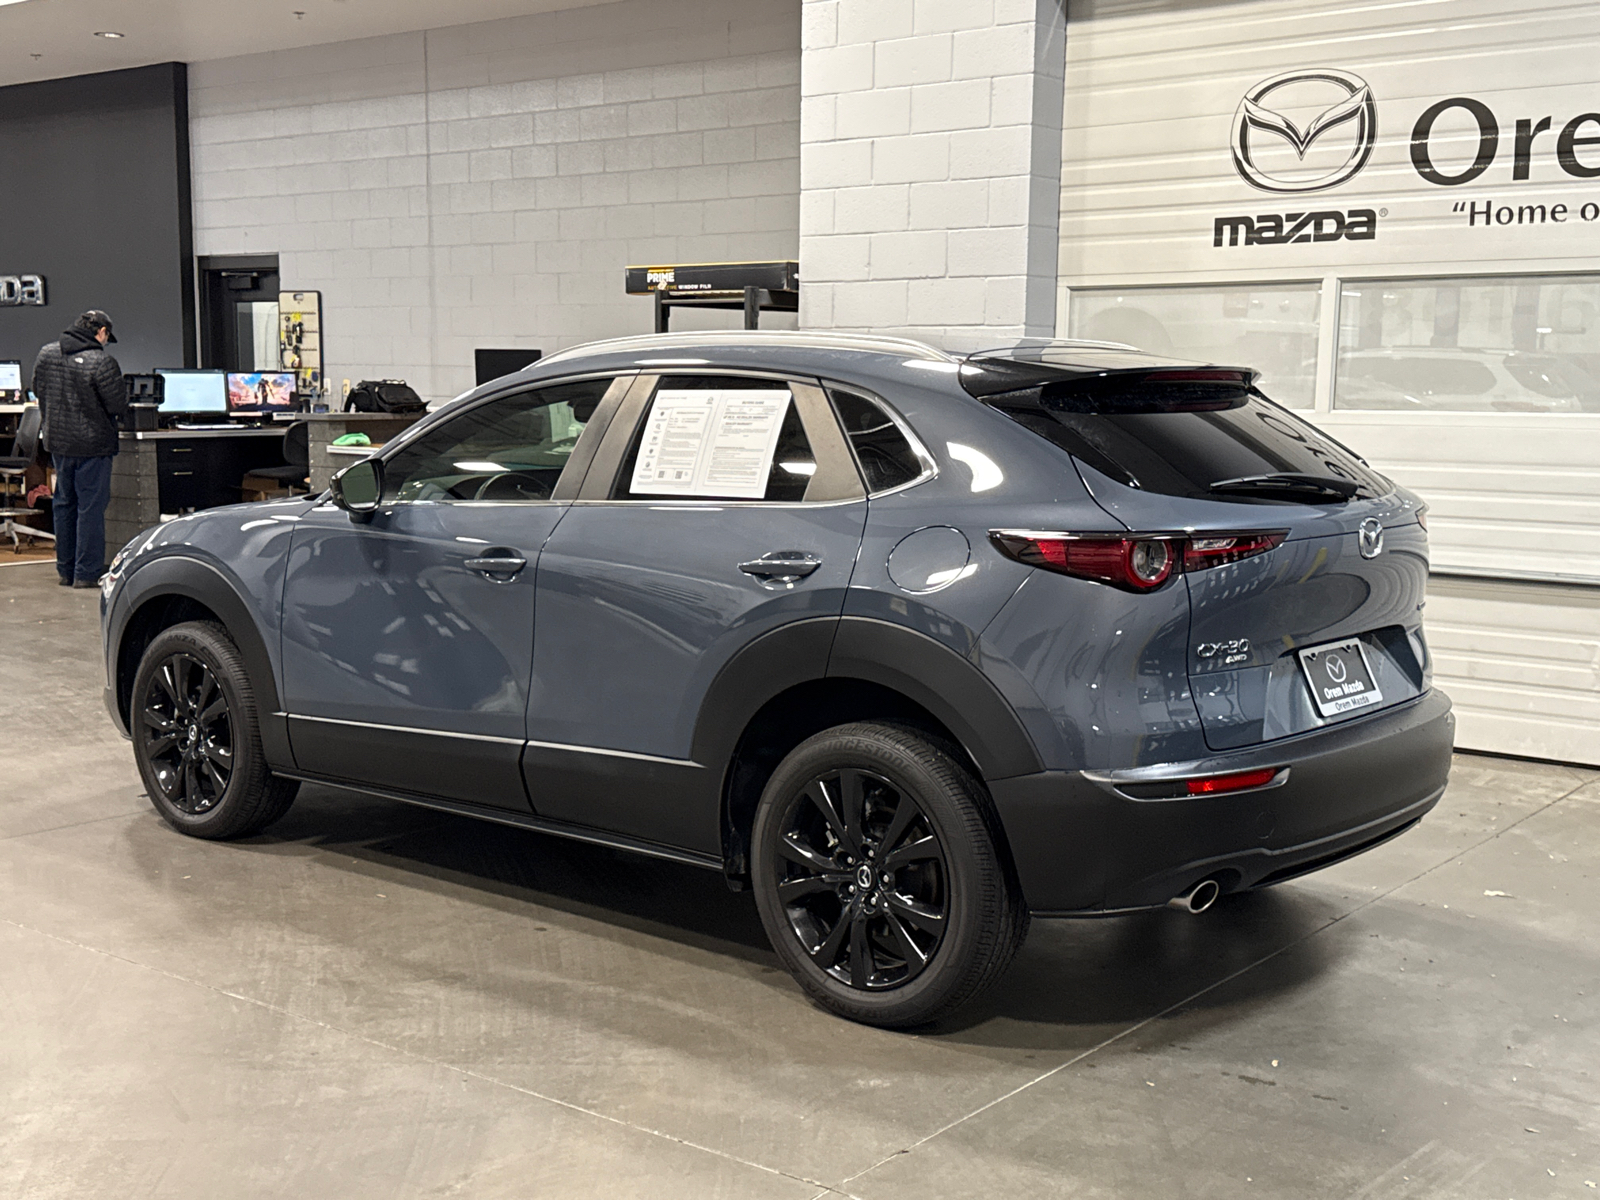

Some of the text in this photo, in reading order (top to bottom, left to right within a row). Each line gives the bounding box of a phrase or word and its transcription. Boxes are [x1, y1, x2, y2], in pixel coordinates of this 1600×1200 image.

[1410, 97, 1600, 186] Ore
[647, 272, 675, 283] PRIME
[1197, 638, 1250, 657] CX-30
[1225, 653, 1247, 663] AWD
[1323, 680, 1365, 700] Orem Mazda
[1335, 695, 1370, 711] Orem Mazda
